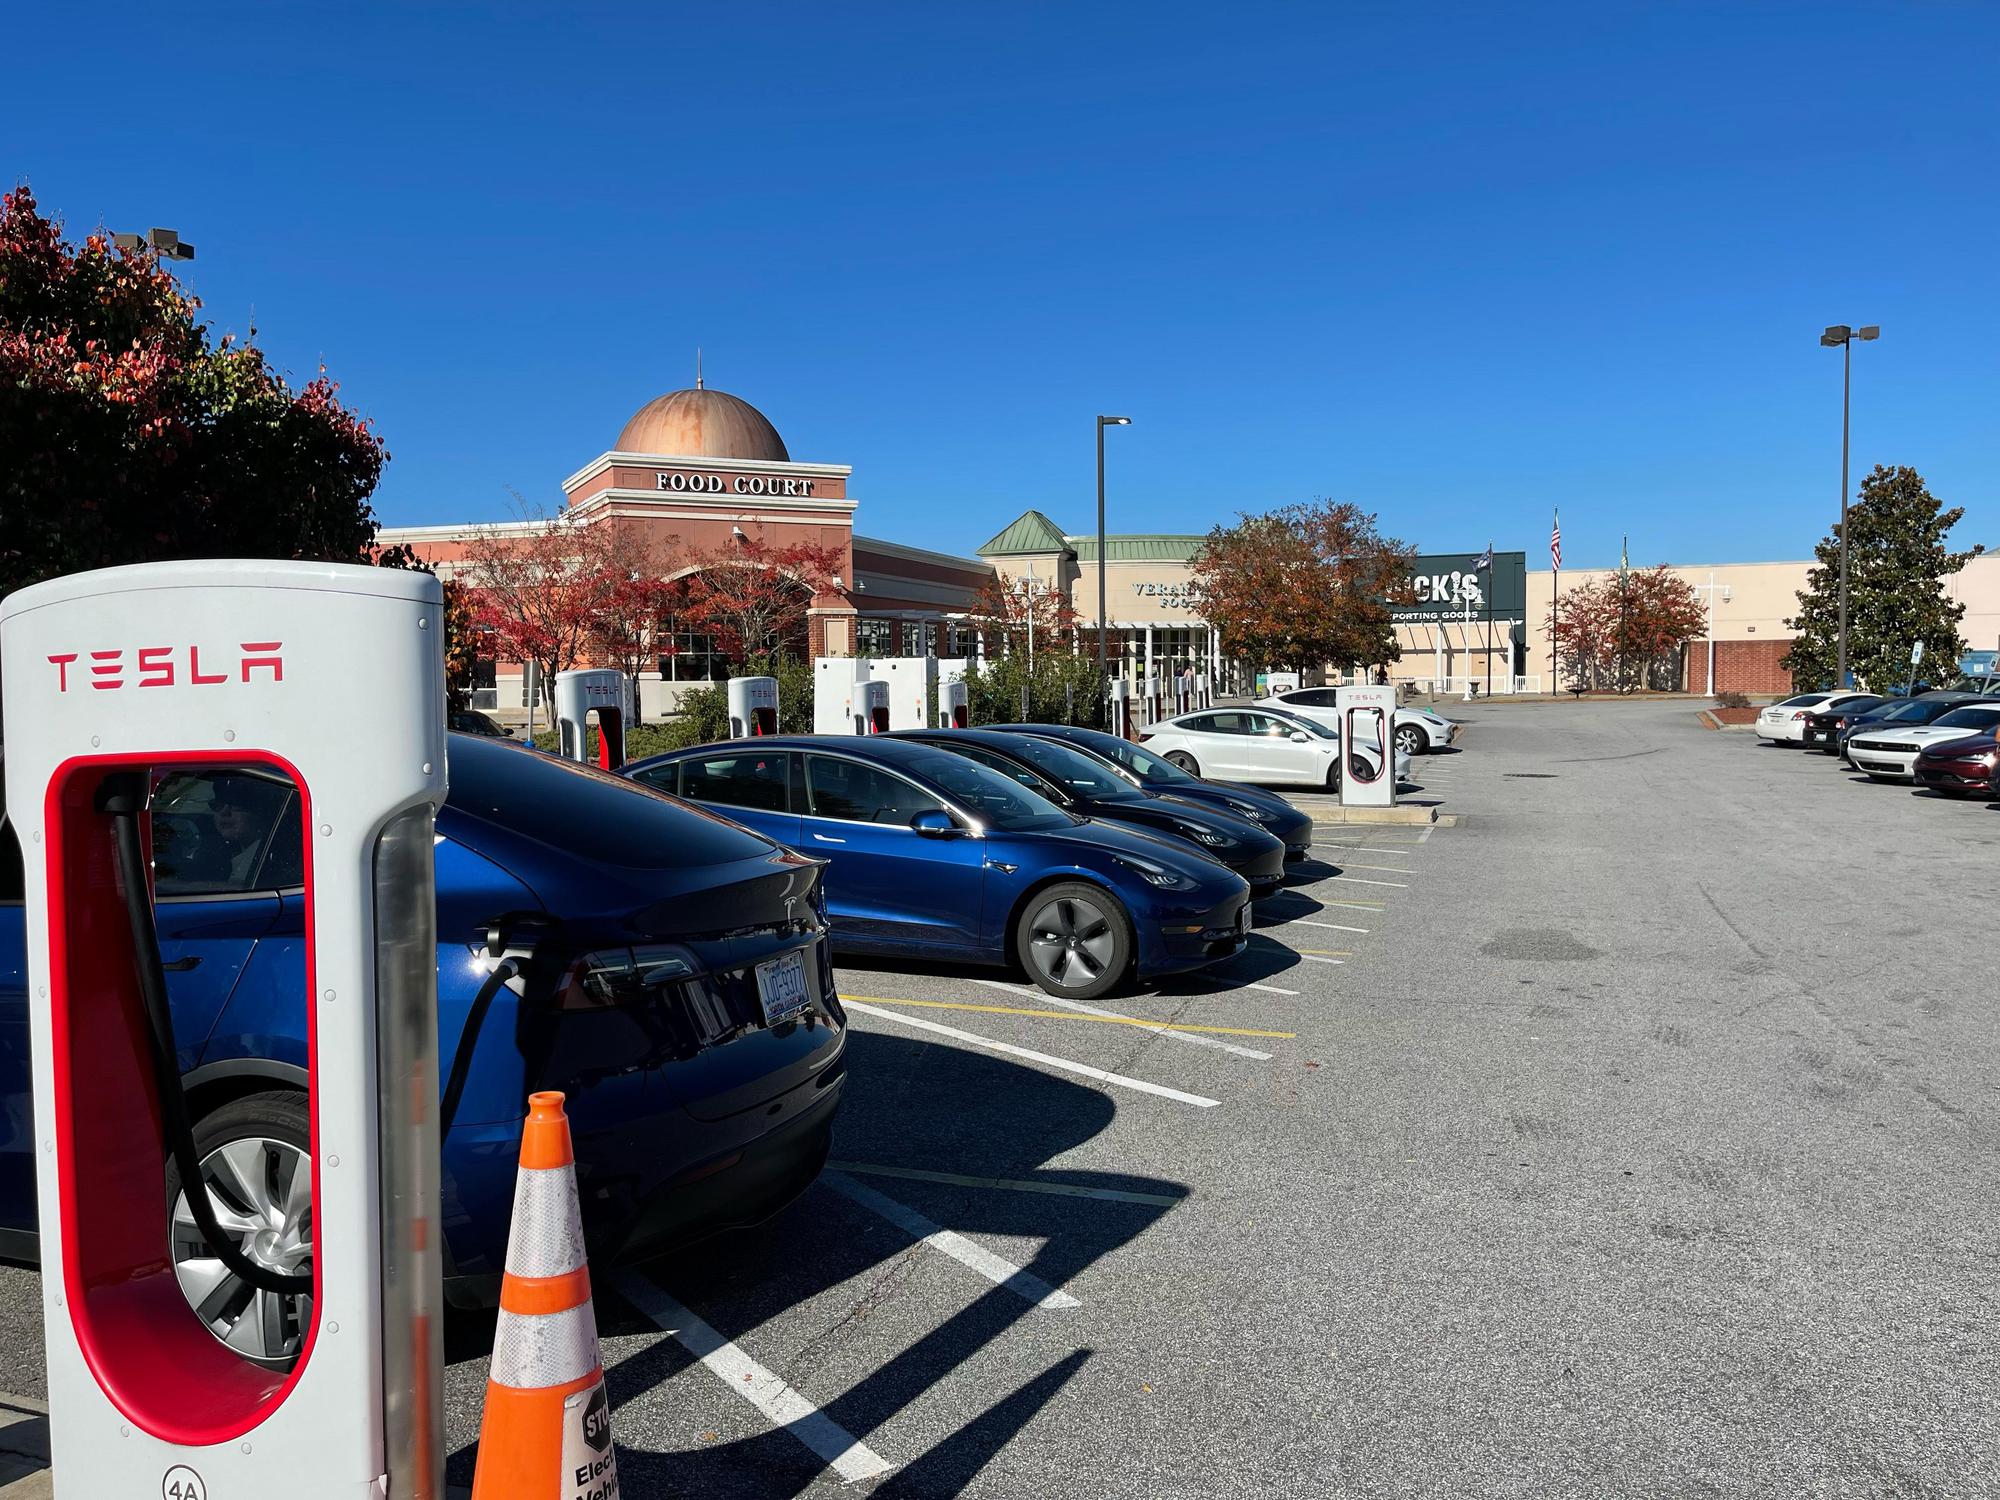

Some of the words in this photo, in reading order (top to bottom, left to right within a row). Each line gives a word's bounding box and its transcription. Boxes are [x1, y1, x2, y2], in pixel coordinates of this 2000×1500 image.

[655, 472, 723, 492] FOOD
[733, 476, 812, 496] COURT
[1132, 583, 1191, 596] VERAN
[1386, 571, 1479, 602] CK'S
[1389, 612, 1438, 620] PORTING
[1441, 611, 1479, 619] GOODS
[47, 642, 283, 692] TESLA
[586, 1403, 609, 1438] STO
[575, 1447, 615, 1487] Elect
[169, 1480, 199, 1500] 4A
